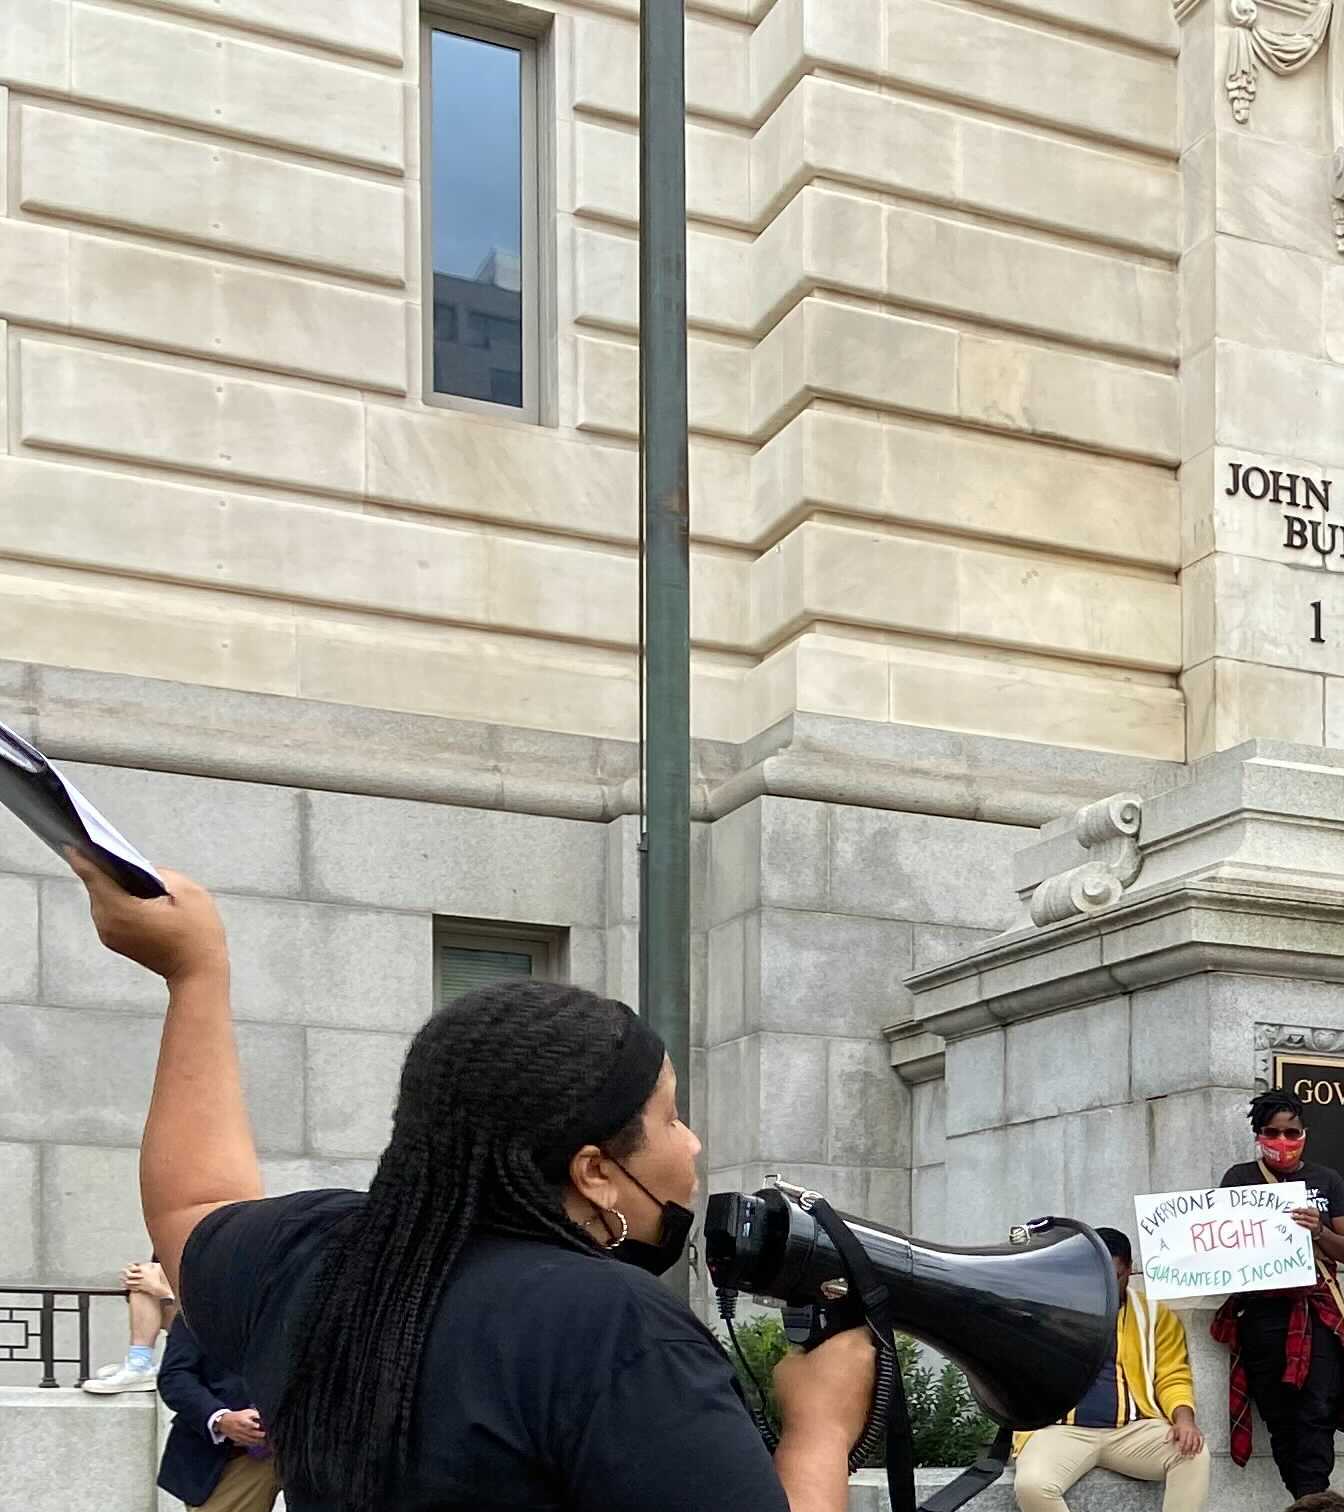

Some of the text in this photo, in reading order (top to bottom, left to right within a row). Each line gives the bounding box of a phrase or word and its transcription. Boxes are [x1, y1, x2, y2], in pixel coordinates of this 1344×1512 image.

[1226, 463, 1332, 512] JOHN
[1140, 1189, 1217, 1236] EVERYONE
[1159, 1238, 1171, 1252] A
[1190, 1218, 1268, 1253] RIGHT
[1145, 1235, 1314, 1287] GUARANTEED INCOME!
